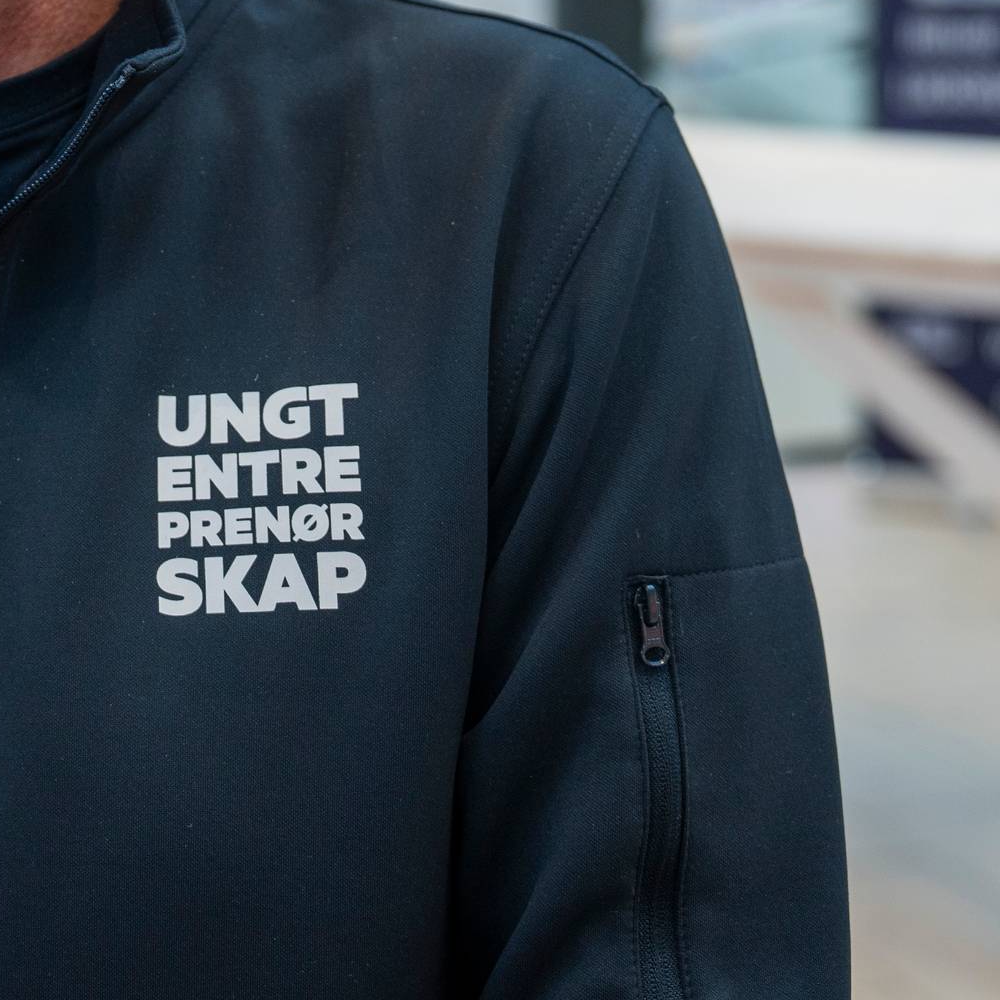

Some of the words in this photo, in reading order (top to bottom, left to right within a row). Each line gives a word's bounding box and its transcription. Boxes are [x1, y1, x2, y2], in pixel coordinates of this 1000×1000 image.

[157, 382, 360, 447] UNGT
[156, 445, 362, 502] ENTRE
[157, 502, 366, 550] PRENØR
[156, 550, 368, 617] SKAP
